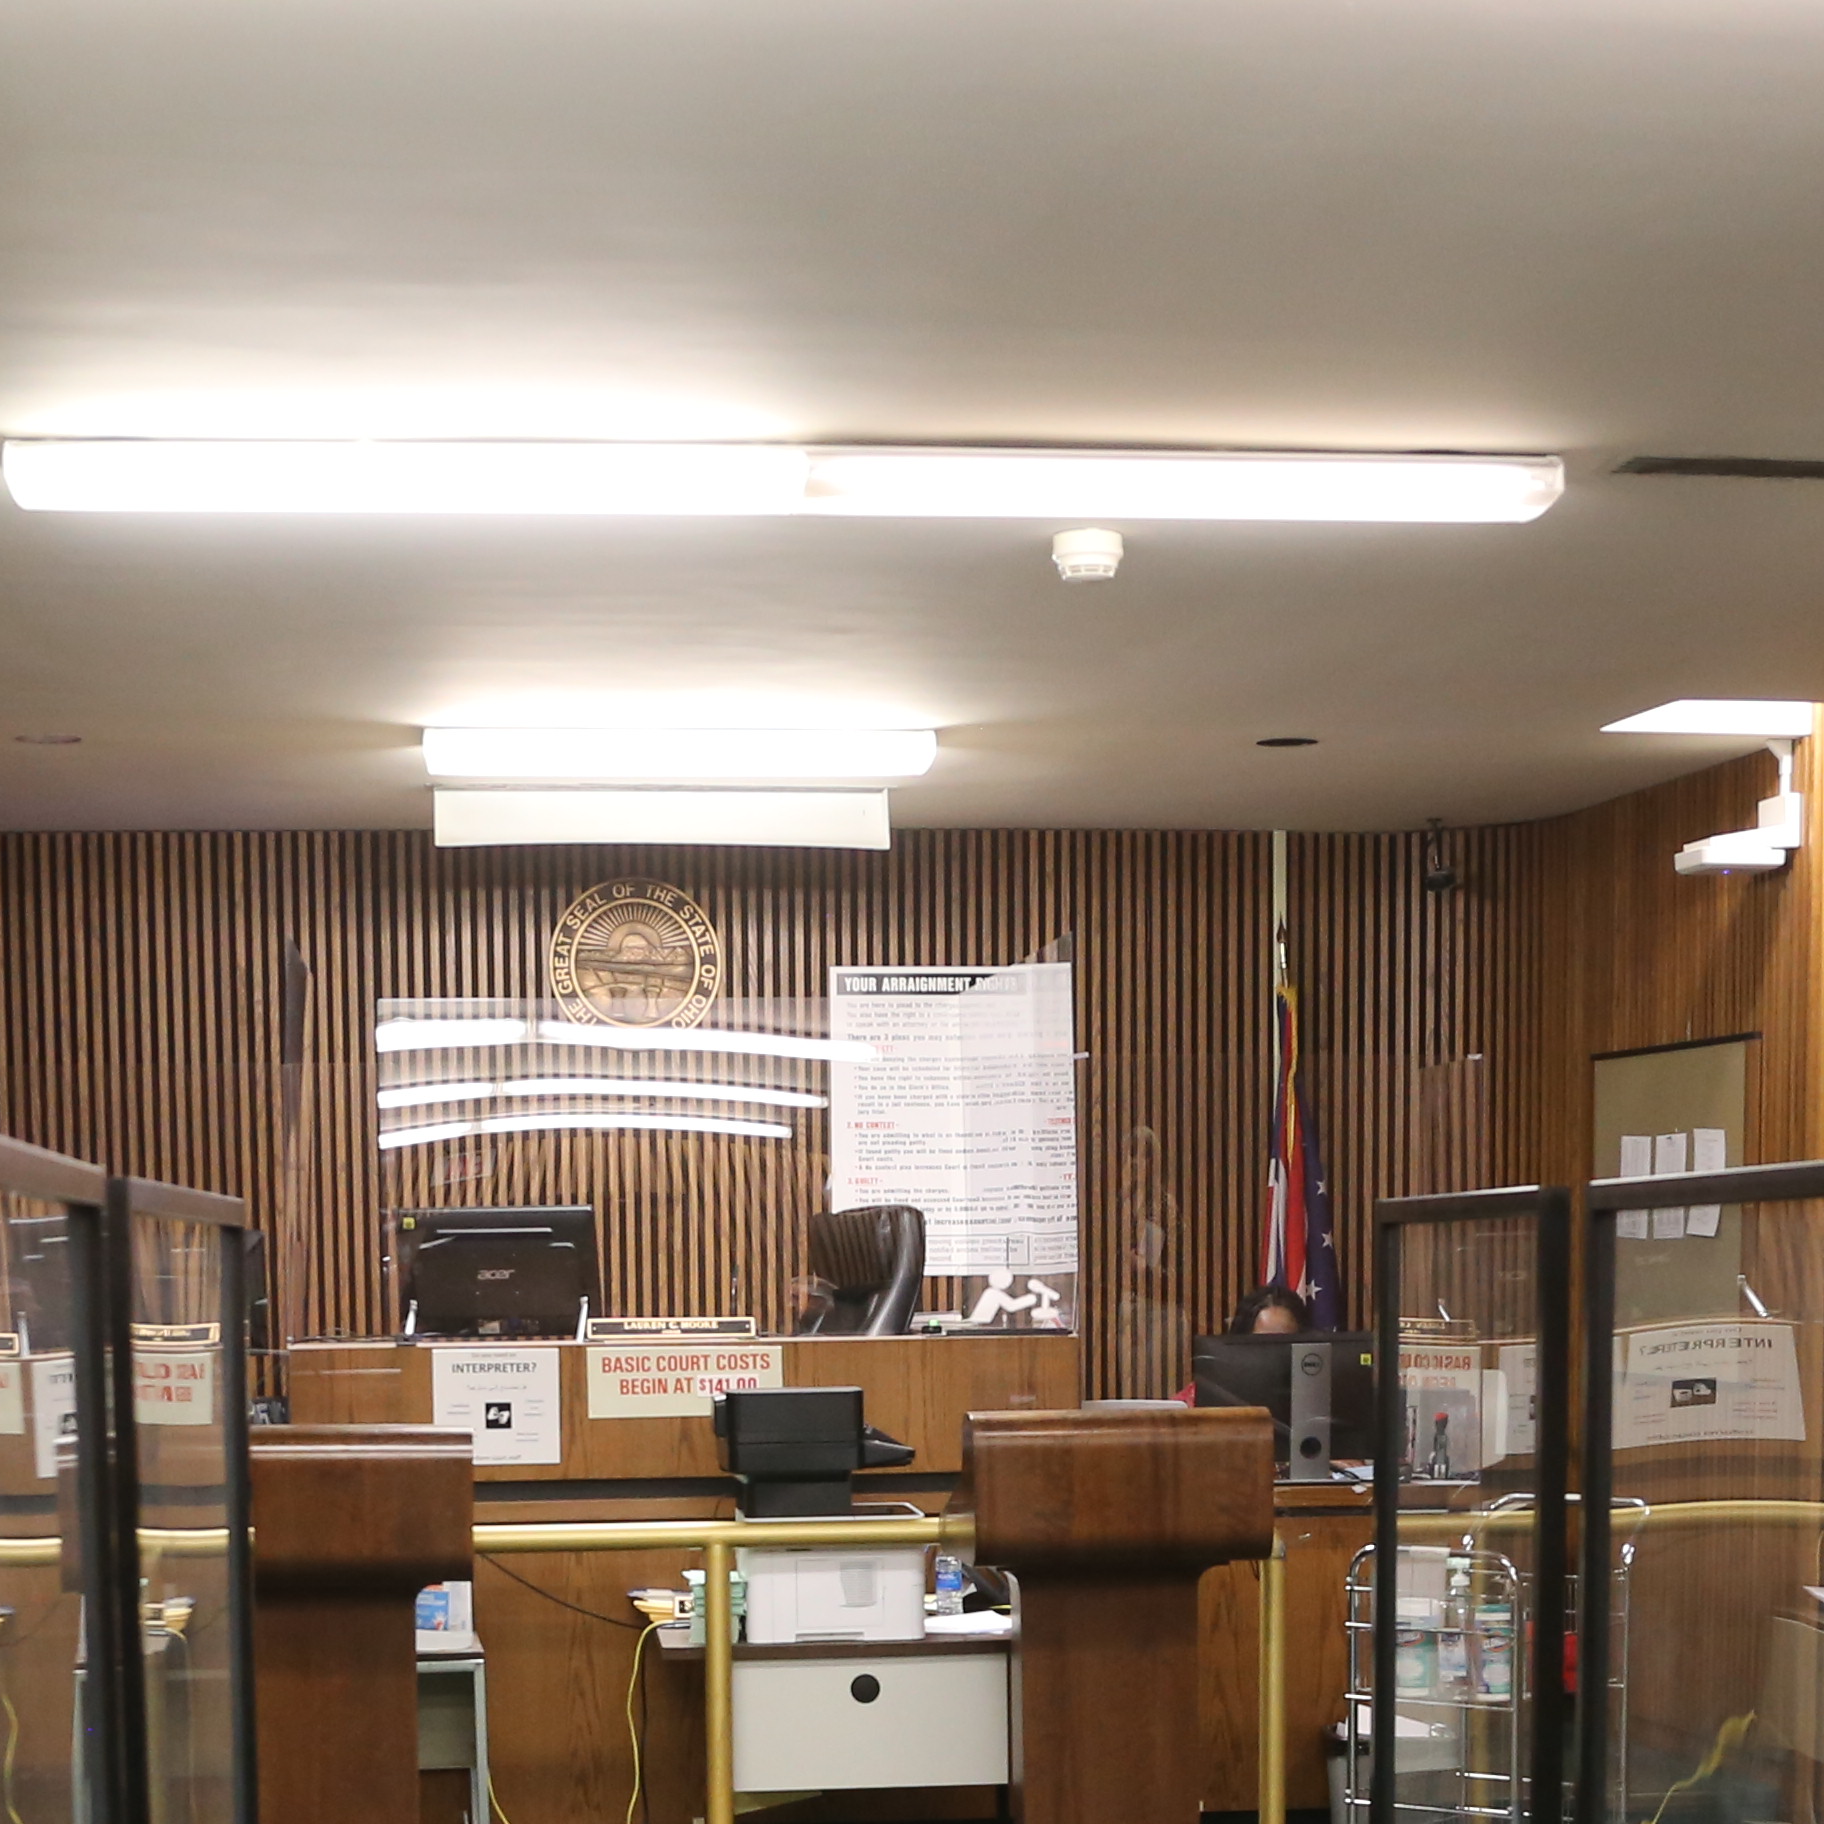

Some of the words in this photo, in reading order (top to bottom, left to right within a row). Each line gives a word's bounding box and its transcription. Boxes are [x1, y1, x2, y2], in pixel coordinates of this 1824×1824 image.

[612, 883, 636, 898] OF
[646, 884, 677, 907] THE
[566, 893, 607, 930] SEAL
[679, 904, 715, 957] STATE
[554, 933, 573, 994] GREAT
[701, 964, 716, 990] OF
[844, 976, 877, 992] YOUR
[881, 976, 972, 992] ARRAIGNMENT
[569, 998, 597, 1027] THE
[671, 994, 707, 1029] OHIO
[478, 1269, 515, 1280] acer
[451, 1362, 537, 1373] INTERPRETER?
[602, 1356, 651, 1373] BASIC
[656, 1354, 711, 1372] COURT
[716, 1353, 771, 1370] COSTS
[620, 1378, 668, 1395] BEGIN
[673, 1377, 694, 1394] AT
[699, 1377, 757, 1394] $14100
